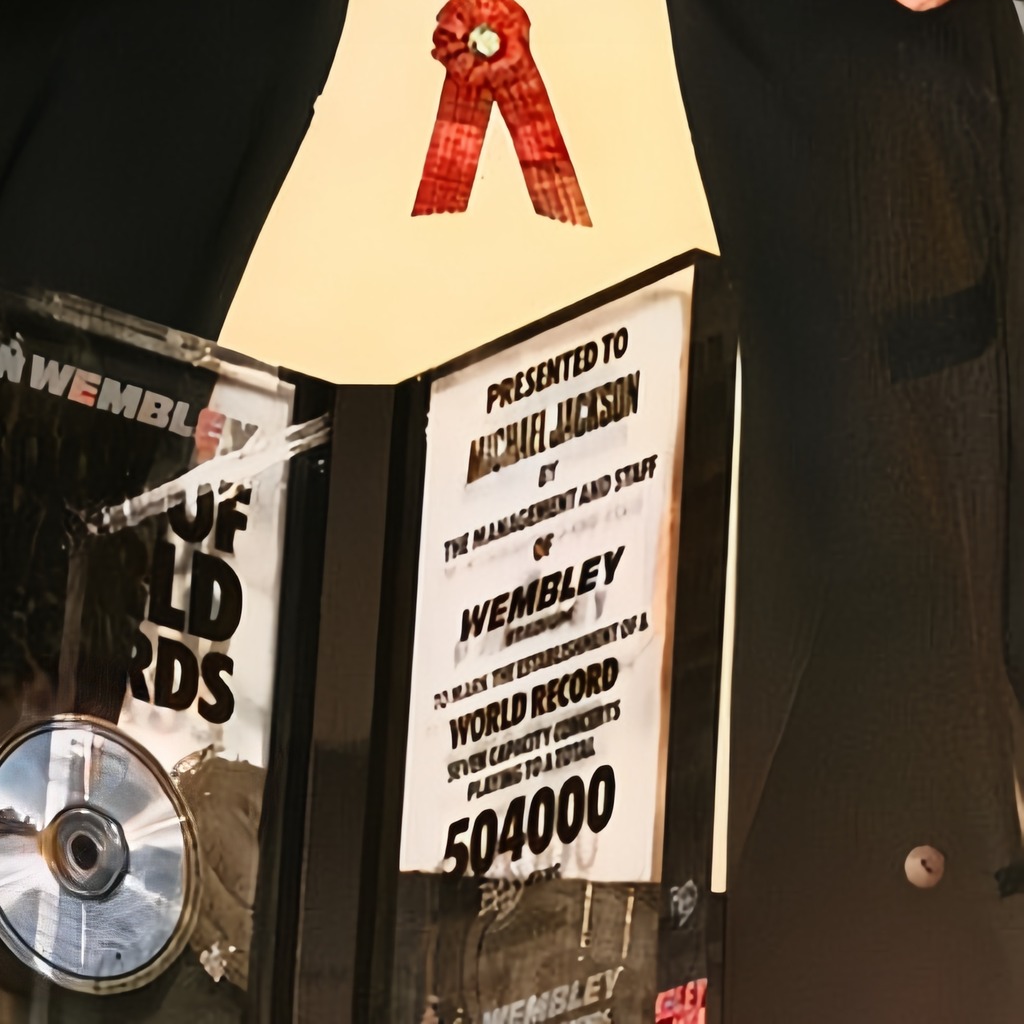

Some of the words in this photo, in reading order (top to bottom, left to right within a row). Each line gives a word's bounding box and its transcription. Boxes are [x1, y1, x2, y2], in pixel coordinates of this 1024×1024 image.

[30, 354, 261, 463] WEMBLEY
[487, 341, 598, 414] PRESENTED
[602, 327, 628, 364] TO
[460, 545, 625, 642] WEMBLEY
[449, 692, 527, 750] WORLD
[531, 657, 619, 718] RECORD
[443, 765, 616, 875] 504000
